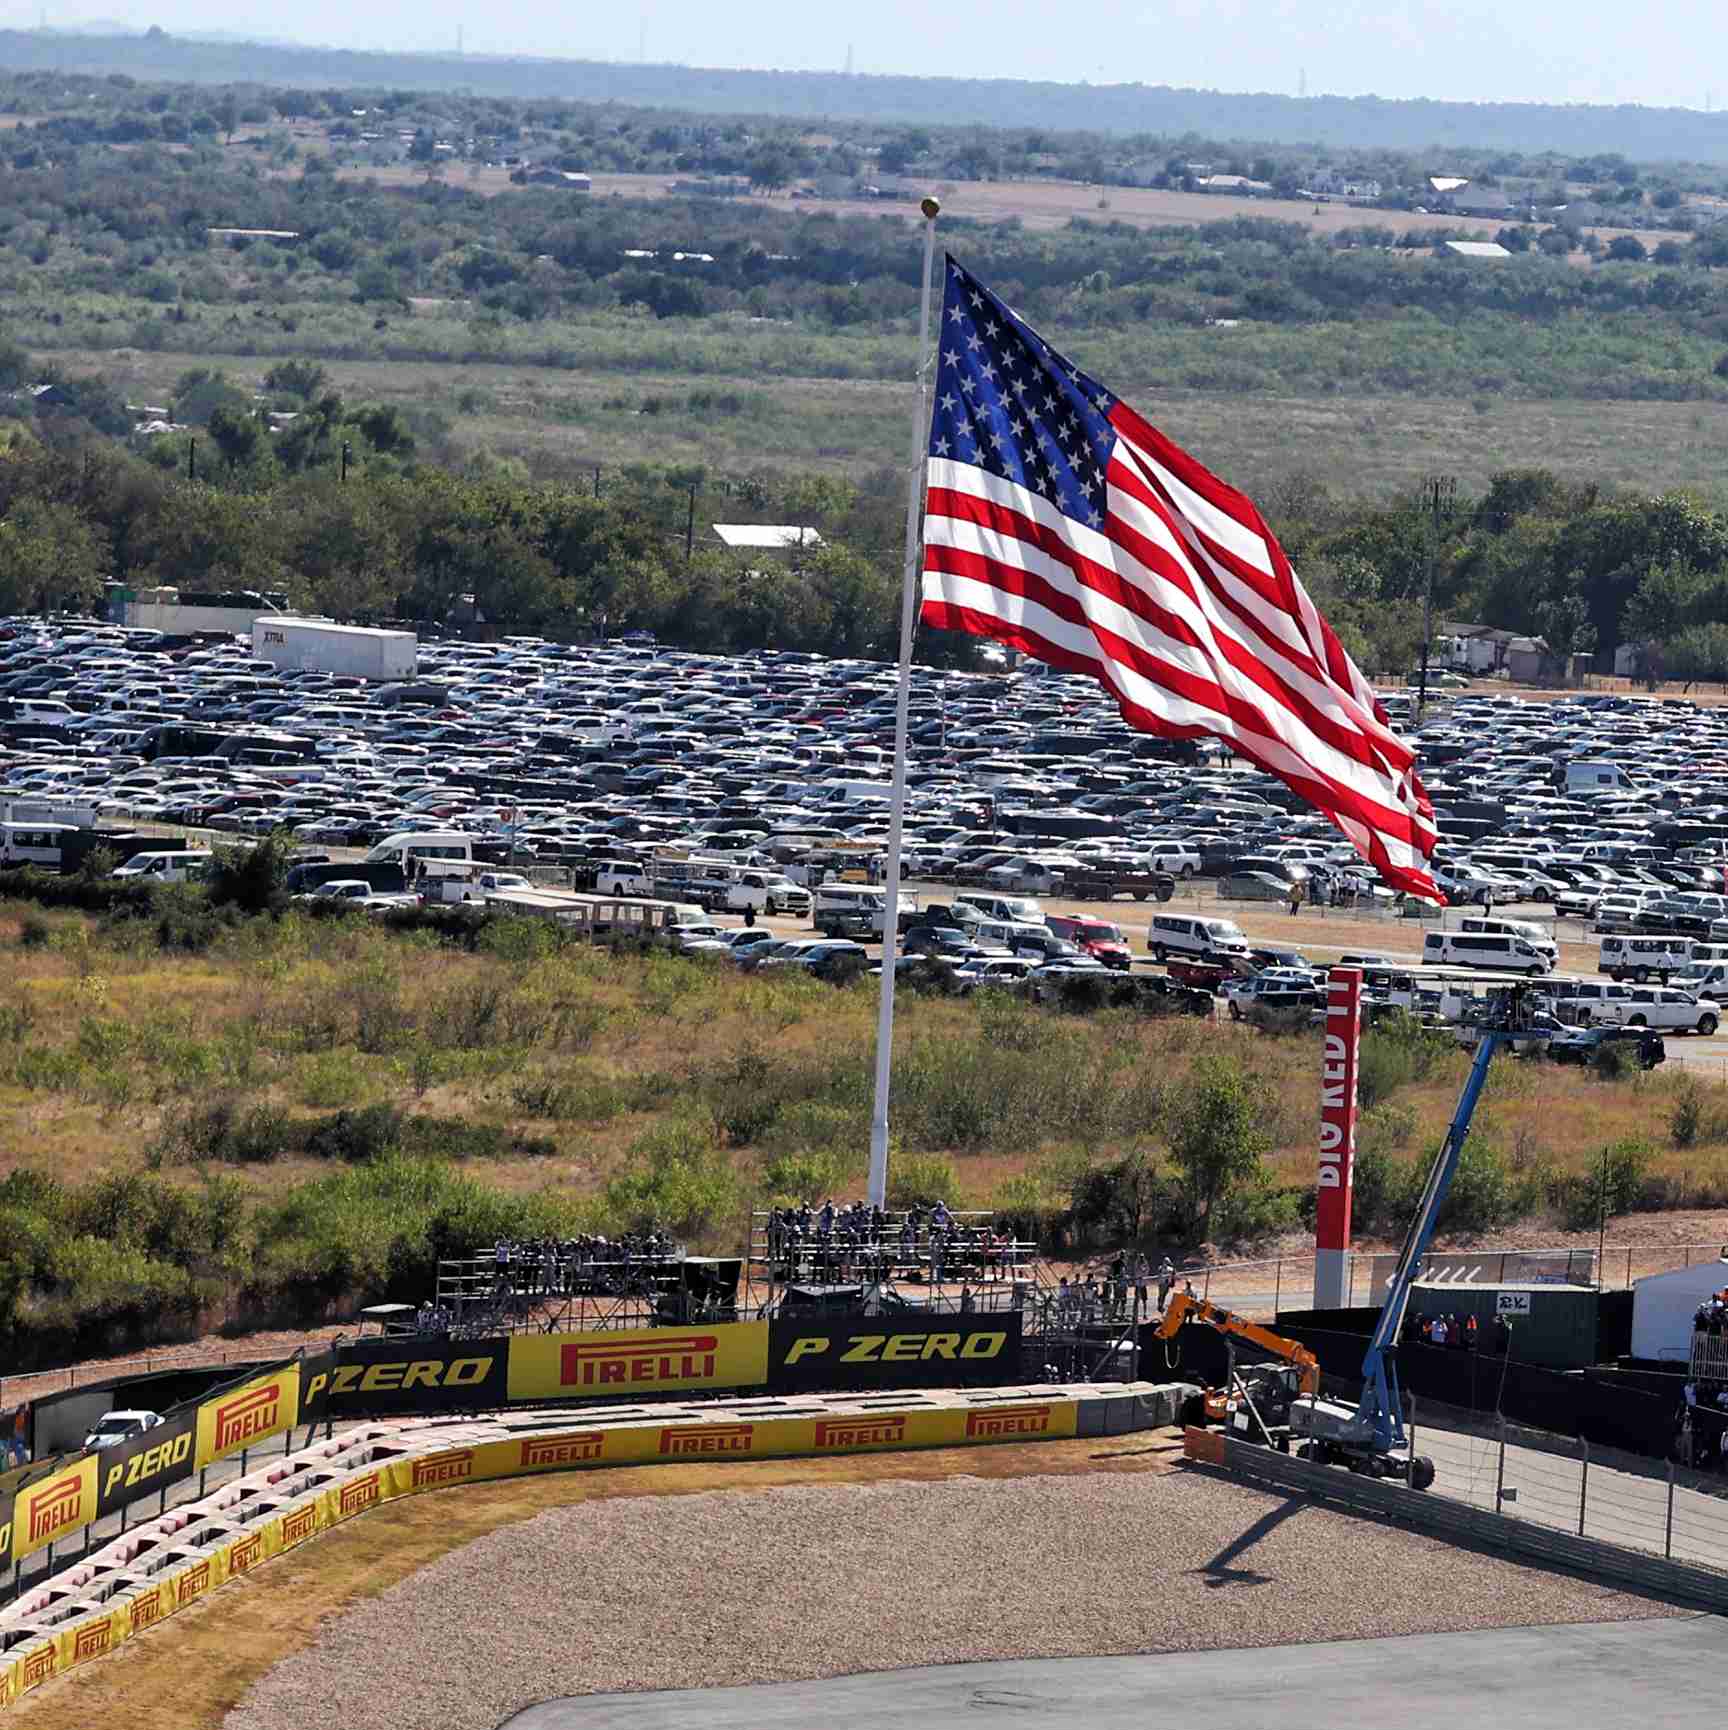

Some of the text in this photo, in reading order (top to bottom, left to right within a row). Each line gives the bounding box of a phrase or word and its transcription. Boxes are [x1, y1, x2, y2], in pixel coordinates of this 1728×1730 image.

[560, 1335, 718, 1385] PIRELLI
[785, 1331, 1008, 1365] P ZERO
[304, 1357, 494, 1406] P ZERO
[214, 1383, 281, 1452] PIRELLI
[658, 1423, 754, 1455] PIRELLI
[815, 1415, 907, 1448] PIRELLI
[964, 1406, 1051, 1438] PIRELLI
[104, 1431, 192, 1499] P ZERO
[411, 1449, 475, 1487] PIRELLI
[520, 1431, 605, 1466] PIRELLI
[28, 1474, 82, 1544] PIRELLI
[338, 1471, 380, 1515] PIRELLI
[280, 1503, 318, 1546] PIRELLI
[75, 1619, 112, 1664] PIRELLI
